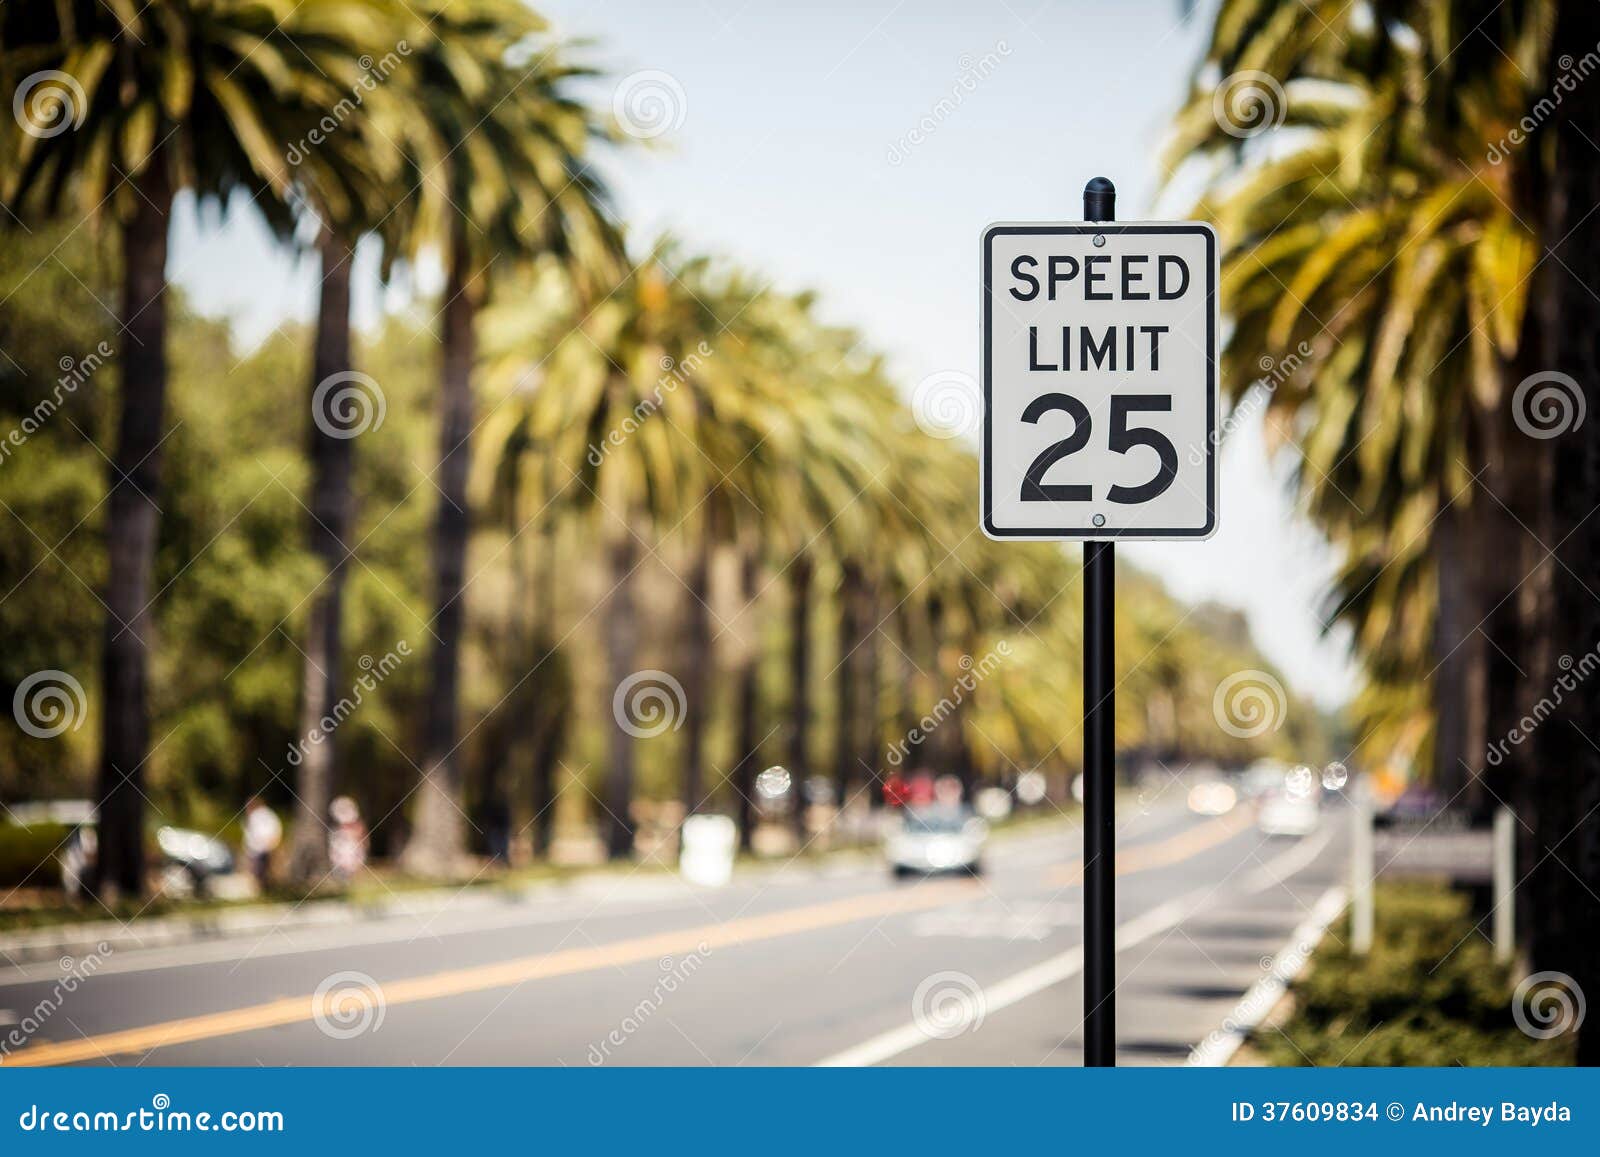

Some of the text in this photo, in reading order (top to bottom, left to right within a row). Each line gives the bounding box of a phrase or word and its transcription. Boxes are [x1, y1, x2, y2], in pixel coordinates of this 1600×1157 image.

[1009, 255, 1190, 301] SPEED
[1030, 326, 1169, 371] LIMIT
[1020, 393, 1178, 504] 25
